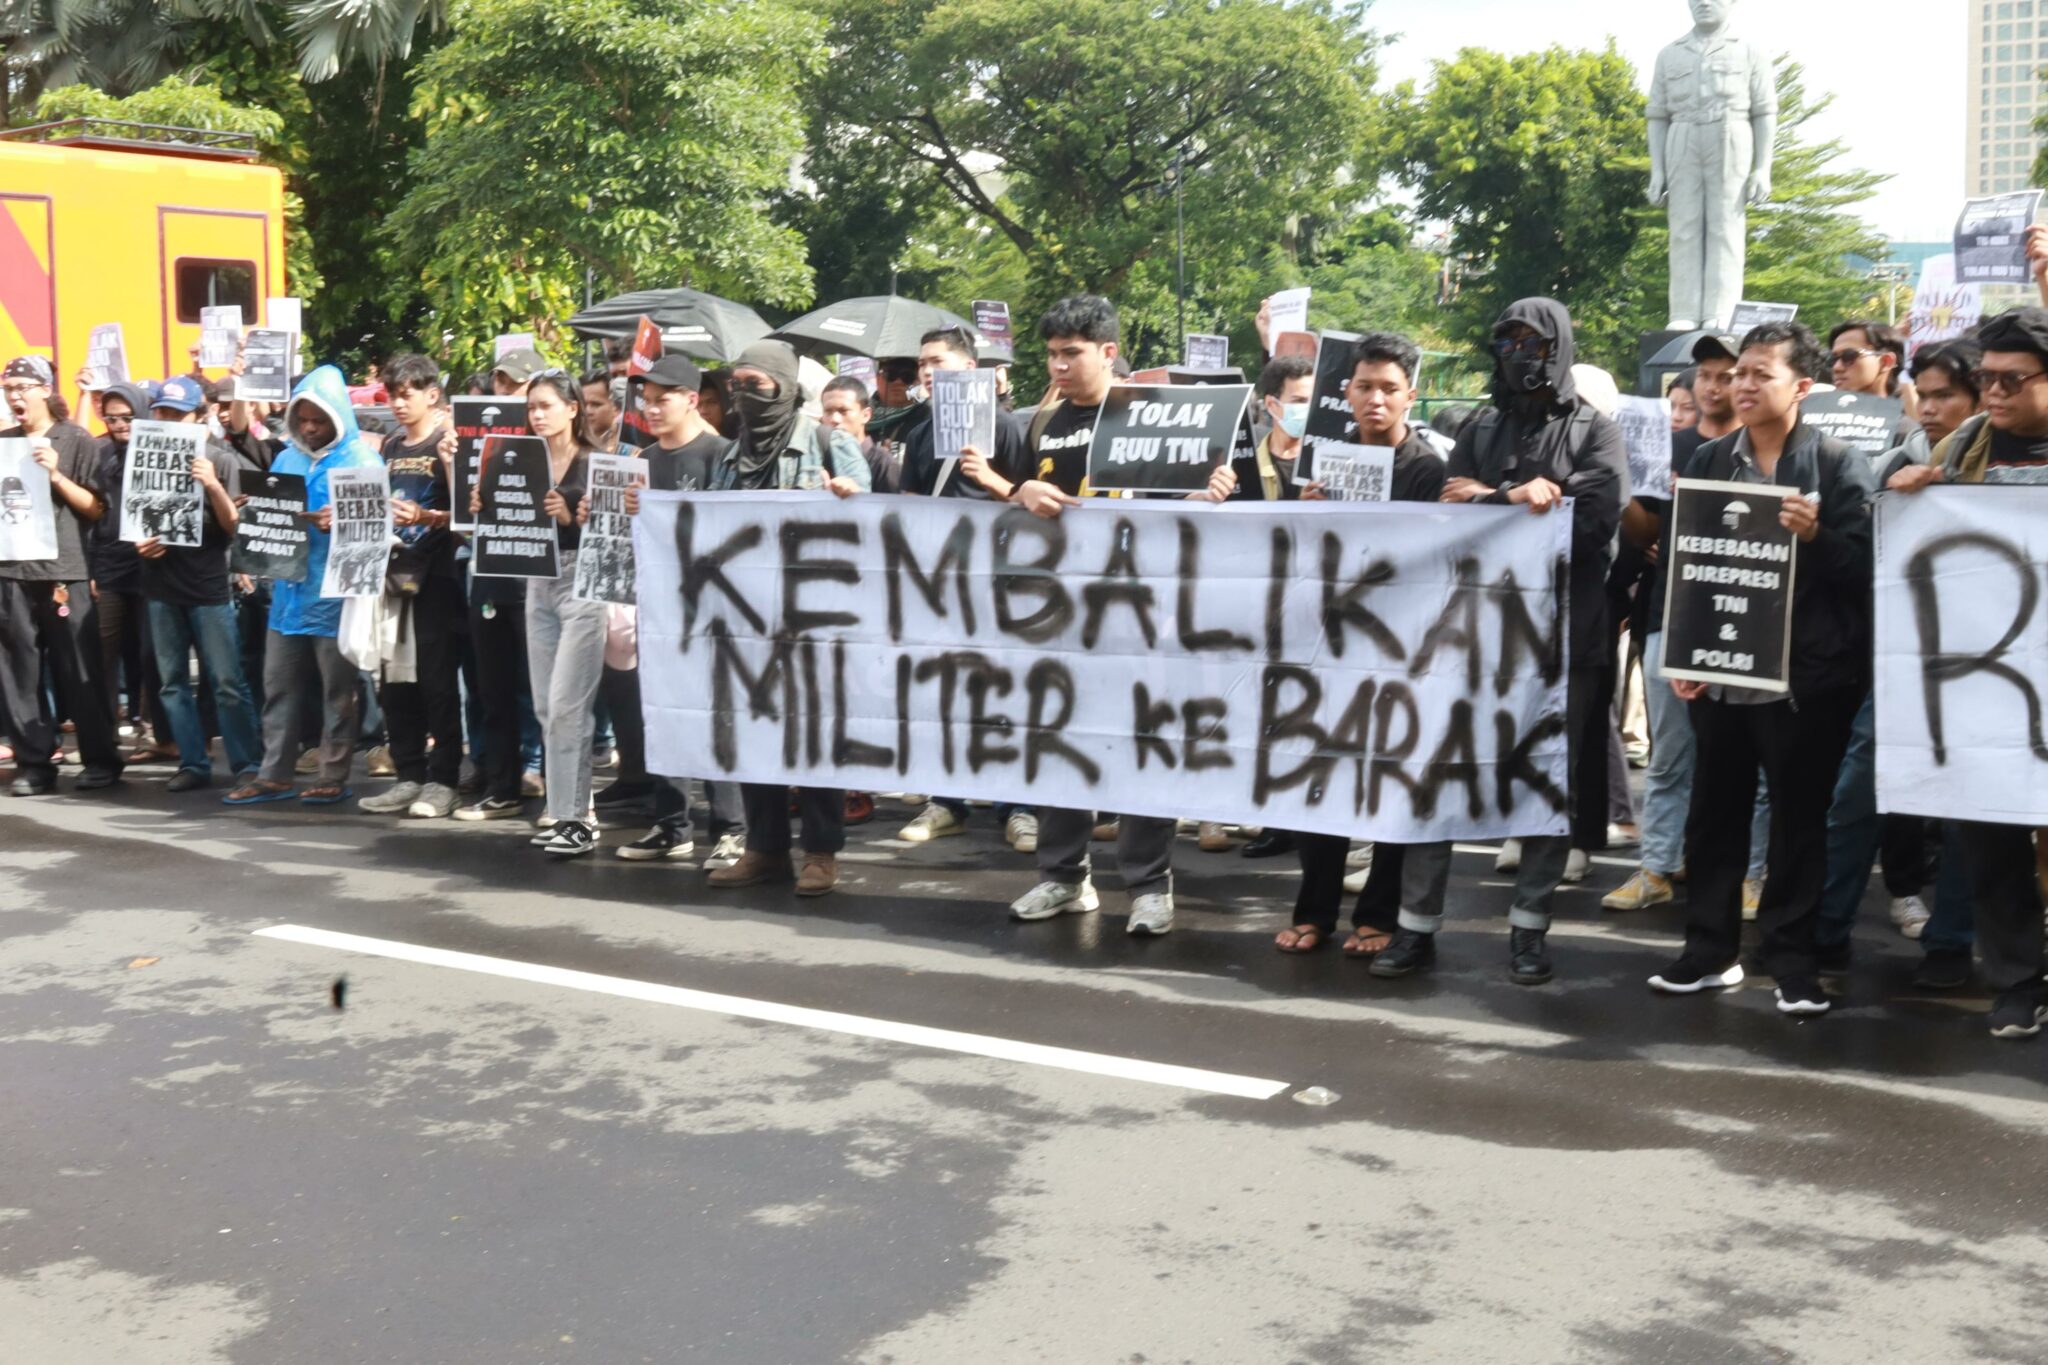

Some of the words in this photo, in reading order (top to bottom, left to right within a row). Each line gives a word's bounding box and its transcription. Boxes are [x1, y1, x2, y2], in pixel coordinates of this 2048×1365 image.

[936, 380, 989, 404] TOLAK
[940, 403, 974, 429] RUU
[1126, 400, 1213, 429] TOLAK
[137, 435, 195, 453] KAWASAN
[940, 428, 969, 452] TNI
[1108, 437, 1162, 465] RUU
[1165, 437, 1210, 465] TNI
[134, 450, 195, 472] BEBAS
[131, 470, 195, 493] MILITER
[1320, 473, 1383, 493] BEBAS
[337, 500, 386, 519] BEBAS
[238, 523, 306, 542] BRUTALITAS
[336, 521, 386, 544] MILITER
[246, 540, 296, 556] APARAT
[1677, 534, 1790, 562] KEBEBASAN
[1681, 563, 1780, 590] DIREPRESI
[676, 499, 1571, 697] KEMBALIKAN
[1711, 593, 1749, 614] TNI
[1718, 623, 1738, 641] &
[1691, 648, 1755, 671] POLRI
[708, 614, 1102, 787] MILITER
[1251, 663, 1570, 820] BARAK
